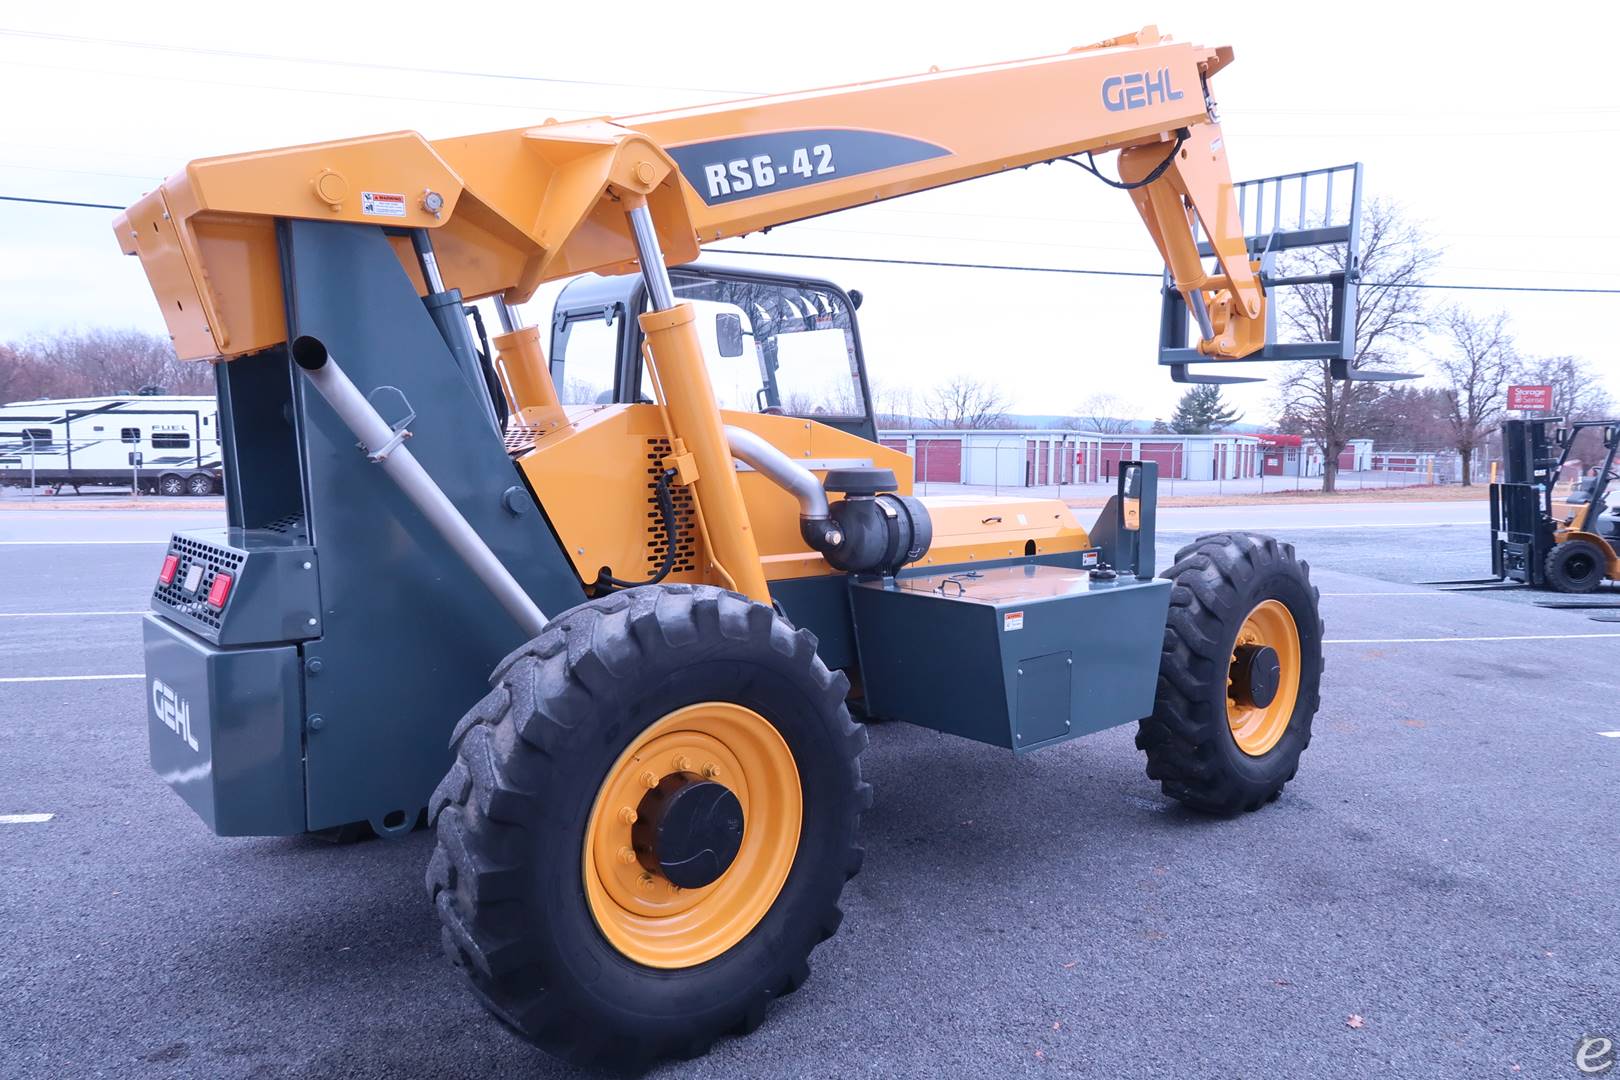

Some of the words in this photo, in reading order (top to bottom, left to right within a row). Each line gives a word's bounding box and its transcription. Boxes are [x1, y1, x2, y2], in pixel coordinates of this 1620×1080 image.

[1102, 67, 1184, 112] GEHL
[704, 144, 835, 197] RS6-42
[1514, 387, 1545, 398] Storage
[152, 679, 199, 752] GEHL
